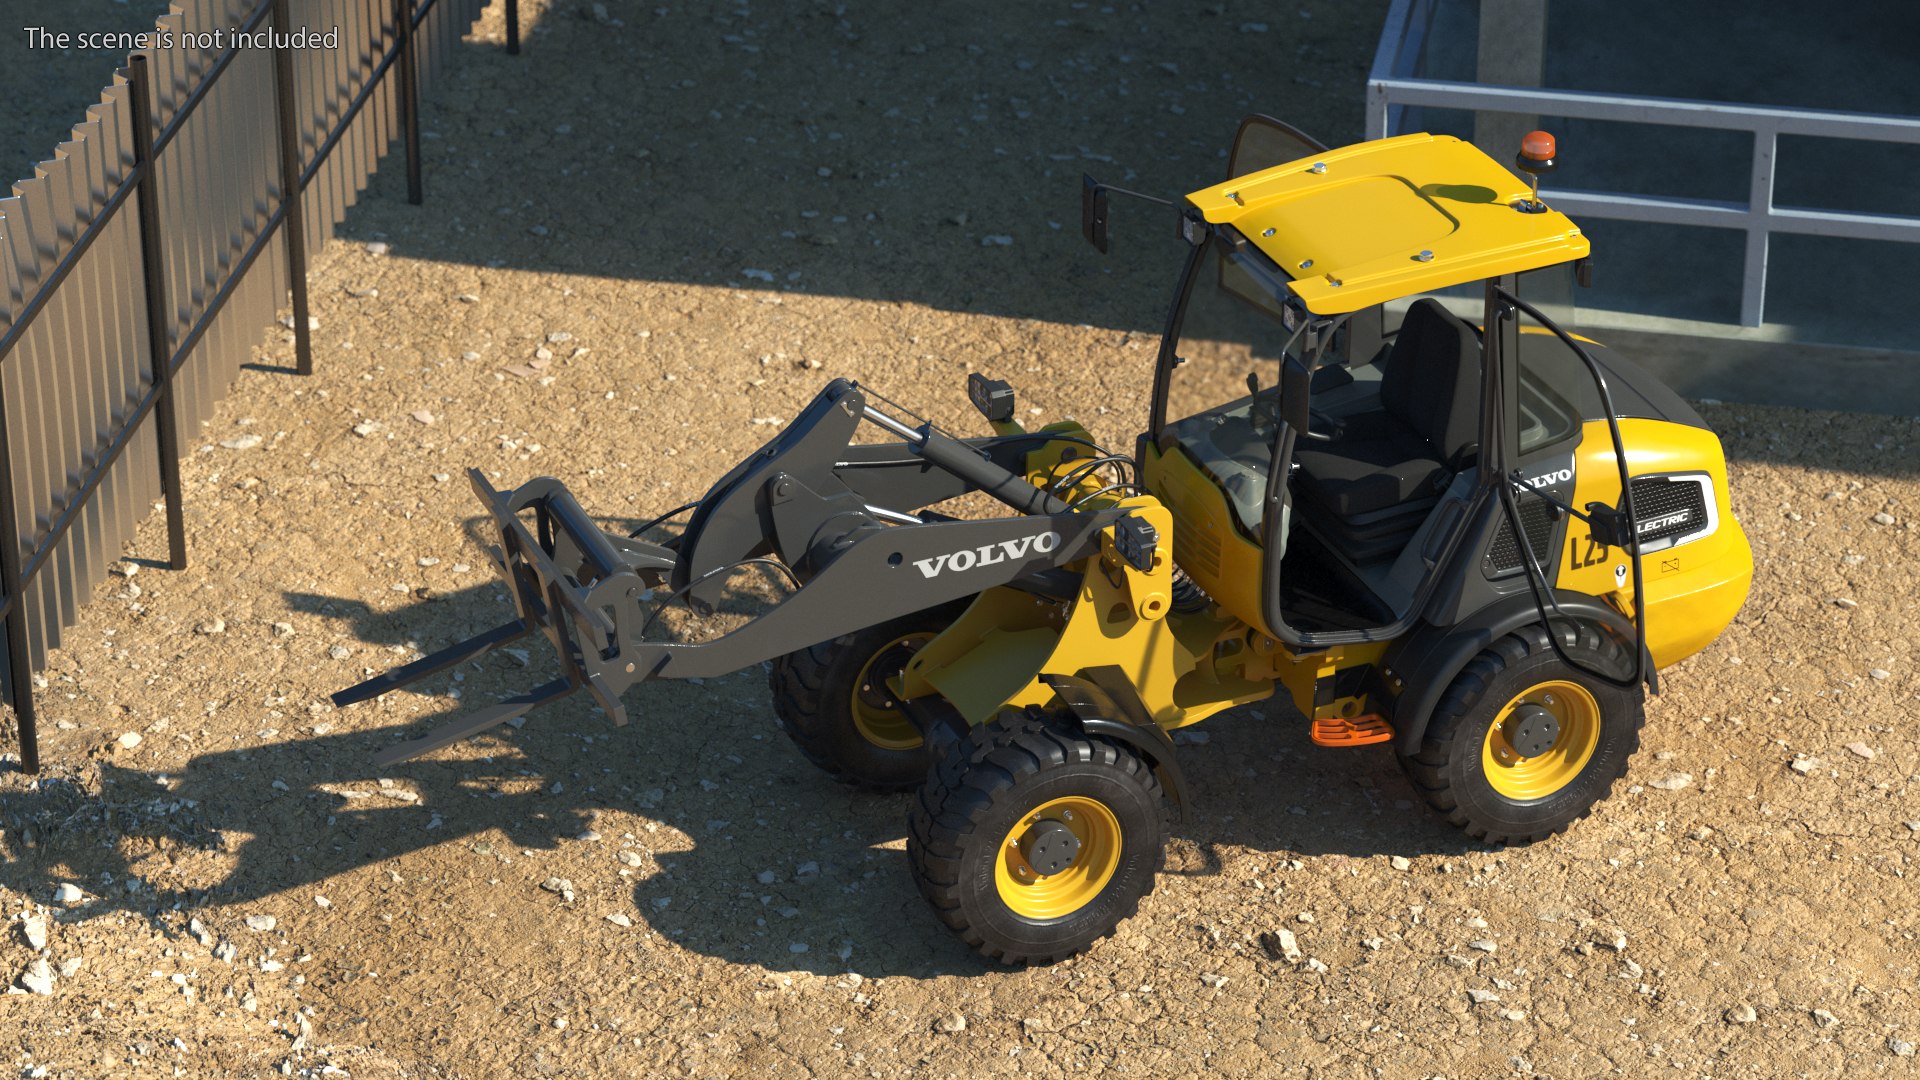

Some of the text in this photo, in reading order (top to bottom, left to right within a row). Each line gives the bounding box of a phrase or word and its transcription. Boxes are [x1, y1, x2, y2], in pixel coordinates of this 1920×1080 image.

[1513, 469, 1572, 492] OLVO
[1636, 512, 1689, 534] LECTRIC
[912, 531, 1061, 579] VOLVO
